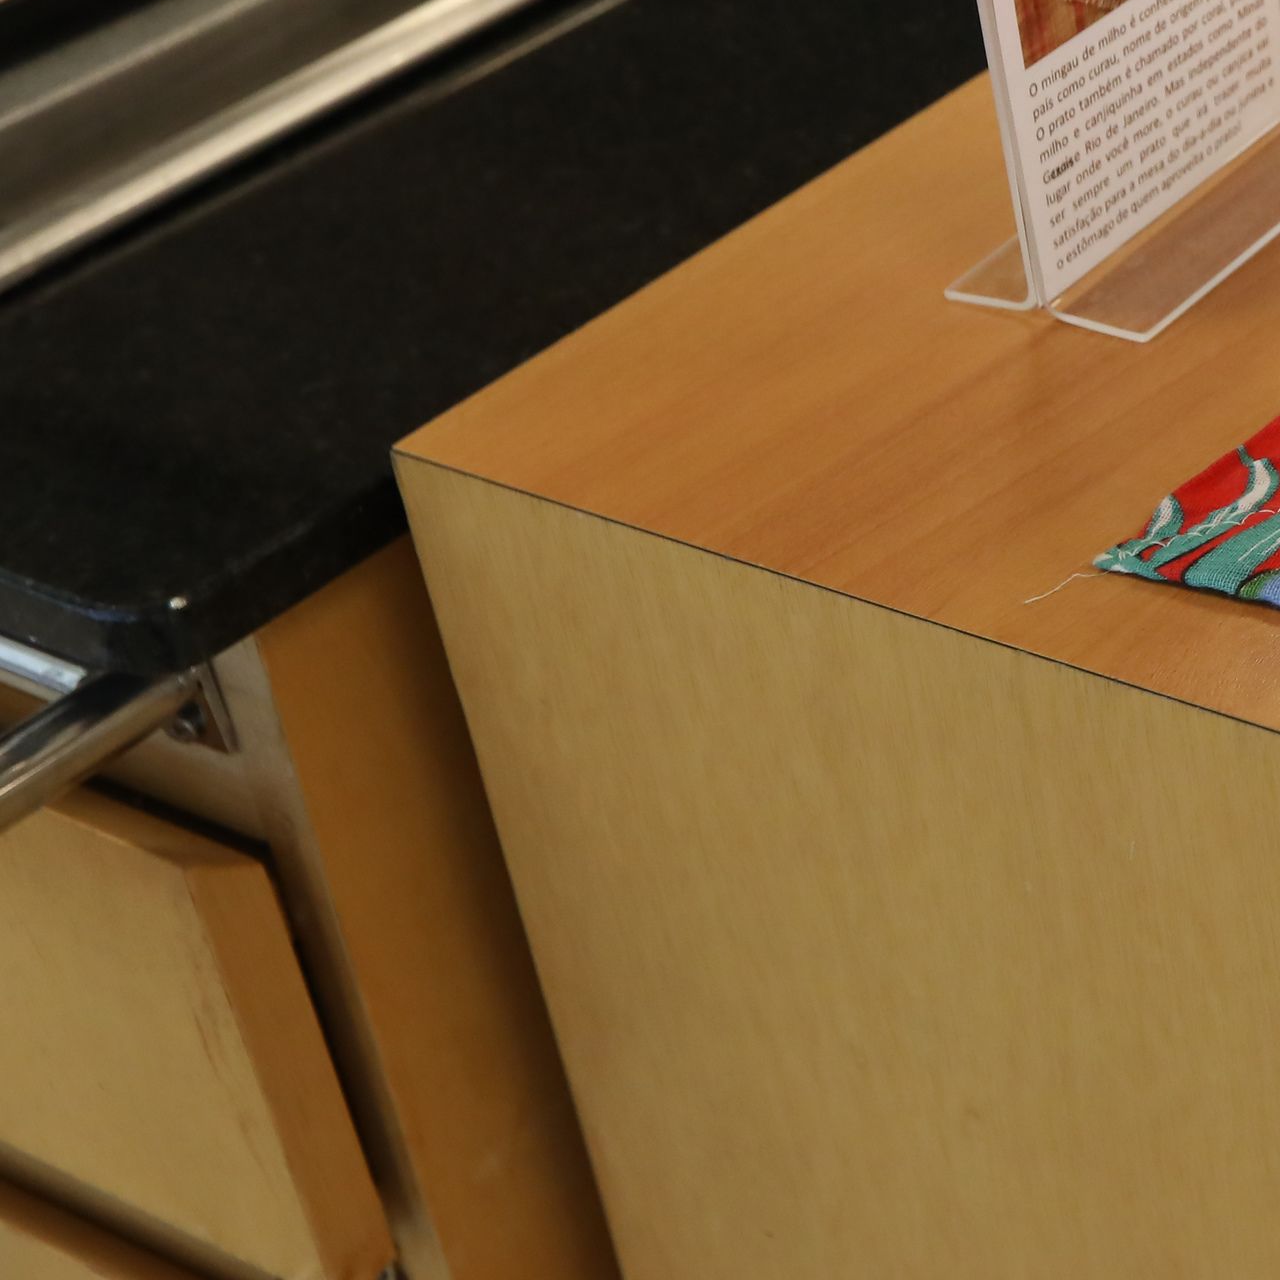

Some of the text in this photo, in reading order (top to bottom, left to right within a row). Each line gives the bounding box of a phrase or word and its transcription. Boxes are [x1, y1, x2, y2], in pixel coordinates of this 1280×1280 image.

[1028, 82, 1038, 97] O
[1040, 55, 1079, 90] mingau
[1081, 45, 1094, 61] de
[1097, 23, 1126, 50] milho
[1129, 14, 1135, 28] é
[1032, 97, 1054, 123] país
[1056, 75, 1085, 103] como
[1088, 53, 1119, 80] curau,
[1122, 30, 1151, 56] nome
[1154, 19, 1166, 34] de
[1035, 126, 1045, 141] O
[1048, 106, 1075, 136] prato
[1078, 74, 1122, 111] também
[1124, 66, 1131, 79] é
[1134, 34, 1179, 72] chamado
[1039, 135, 1069, 164] milho
[1073, 127, 1079, 138] e
[1084, 82, 1142, 131] canjiquinha
[1146, 69, 1163, 86] em
[1166, 39, 1203, 72] estados
[1045, 180, 1070, 207] lugar
[1075, 159, 1101, 184] onde
[1104, 135, 1129, 162] você
[1132, 117, 1162, 143] more,
[1165, 107, 1173, 119] o
[1073, 151, 1080, 162] e
[1084, 136, 1101, 154] Rio
[1105, 123, 1118, 139] de
[1164, 77, 1184, 96] Mas
[1049, 208, 1064, 227] ser
[1072, 176, 1109, 210] sempre
[1116, 159, 1133, 177] um
[1139, 135, 1166, 164] prato
[1052, 205, 1102, 249] satisfação
[1104, 187, 1126, 213] para
[1129, 181, 1135, 191] a
[1137, 159, 1165, 184] mesa
[1166, 148, 1180, 164] do
[1056, 258, 1064, 270] o
[1065, 219, 1114, 263] estômago
[1115, 208, 1128, 224] de
[1130, 185, 1159, 213] quem
[1160, 151, 1204, 191] aproveita
